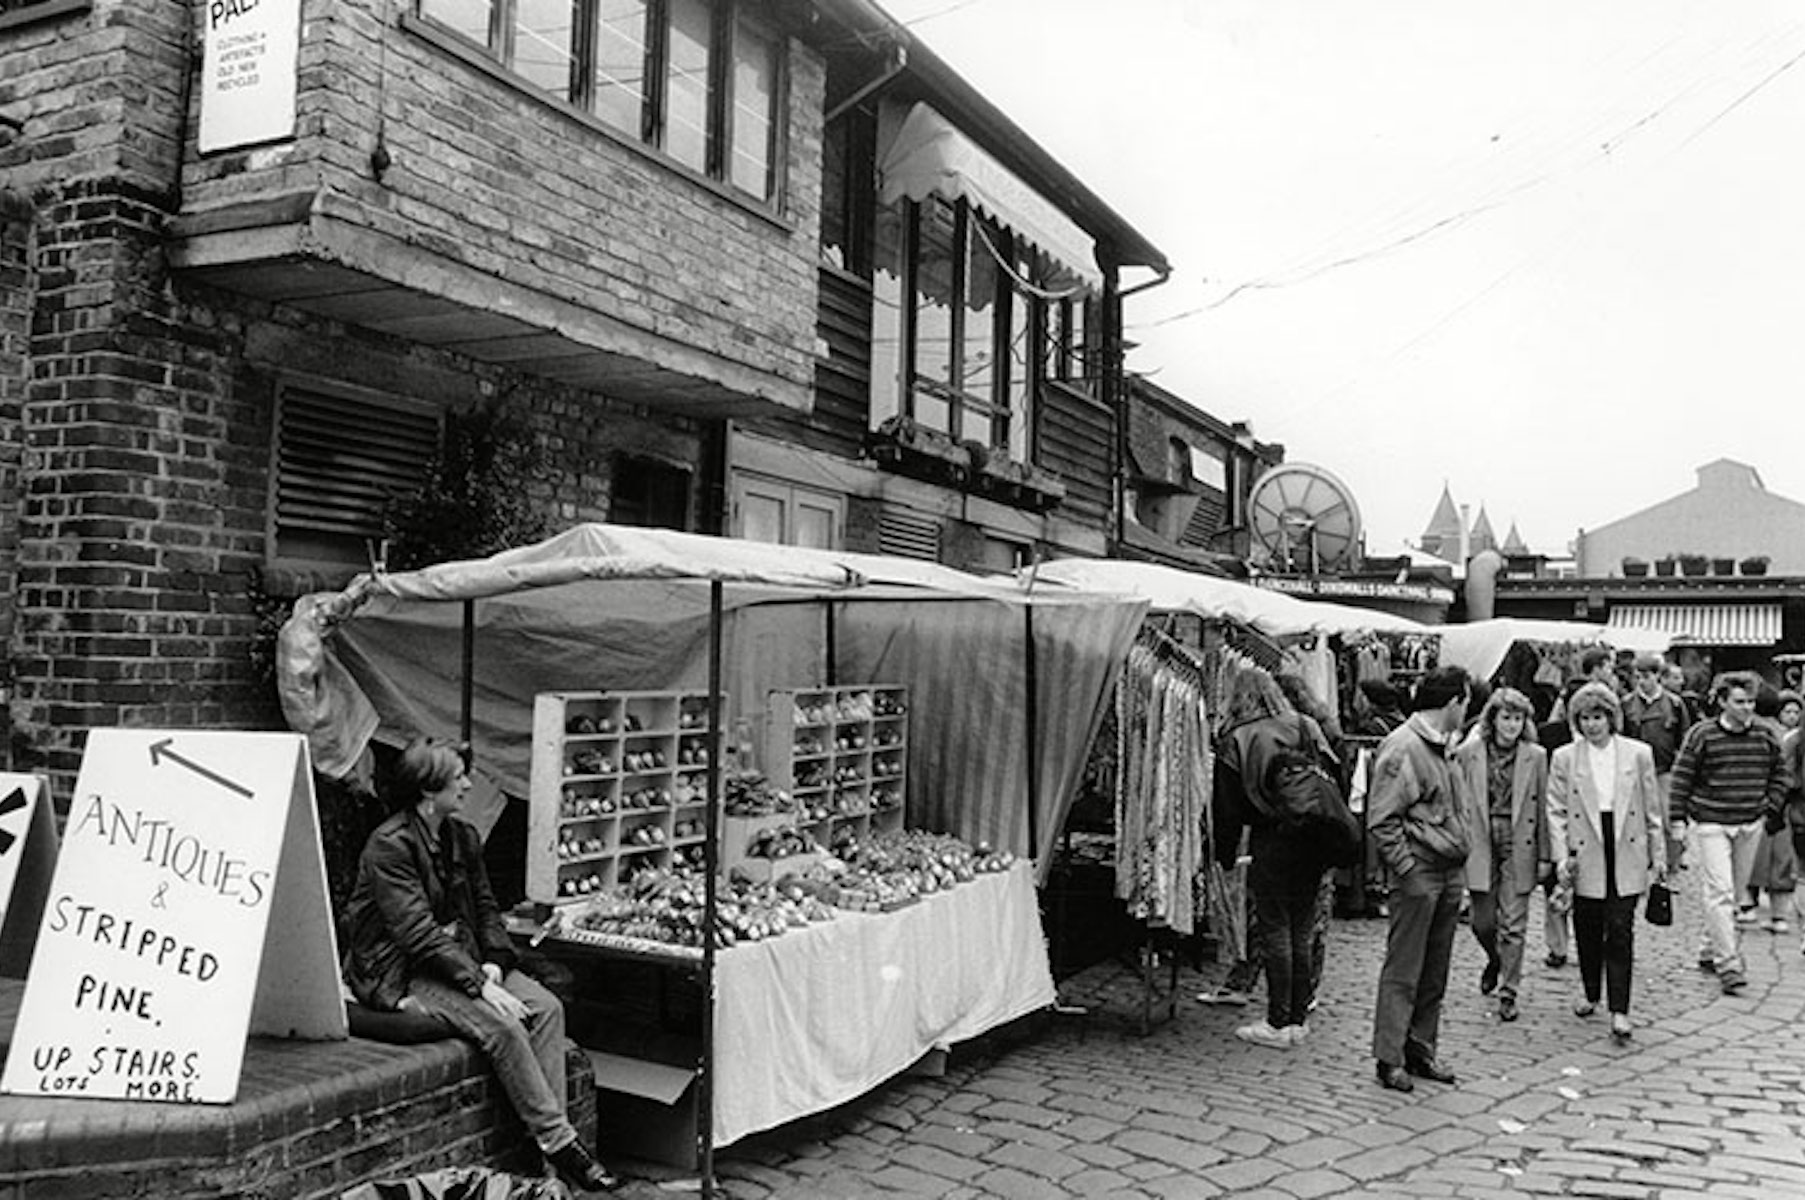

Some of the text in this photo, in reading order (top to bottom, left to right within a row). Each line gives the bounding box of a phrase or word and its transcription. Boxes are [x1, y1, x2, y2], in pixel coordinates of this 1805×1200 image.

[216, 64, 235, 78] OLD
[73, 794, 271, 908] ANTIQUES
[151, 881, 170, 909] &
[50, 896, 219, 982] STRIPPED
[75, 974, 162, 1027] PINE.
[33, 1046, 201, 1080] UP STAIRS.
[39, 1076, 91, 1093] LOTS
